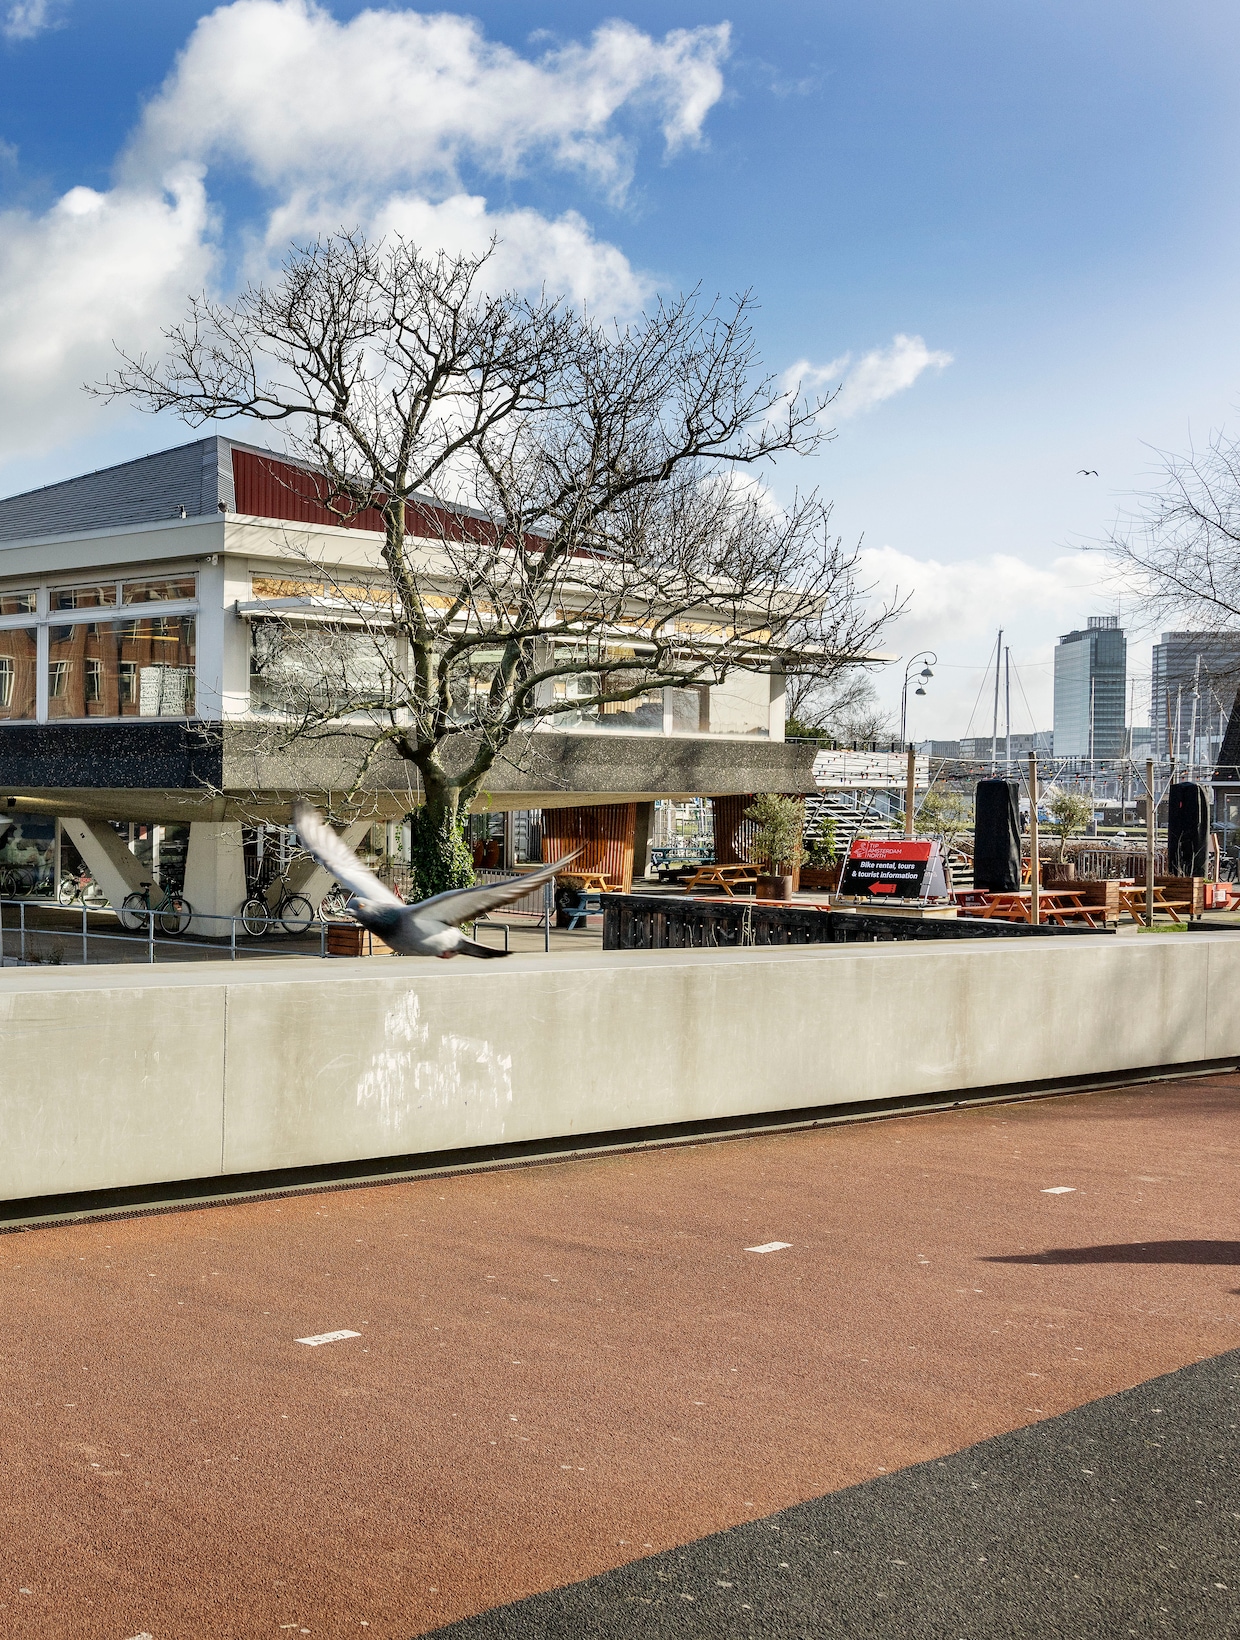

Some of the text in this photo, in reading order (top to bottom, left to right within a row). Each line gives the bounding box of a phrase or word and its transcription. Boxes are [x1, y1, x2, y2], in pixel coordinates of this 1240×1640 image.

[860, 861, 875, 869] Bike
[876, 862, 896, 870] rental,
[880, 871, 918, 879] information
